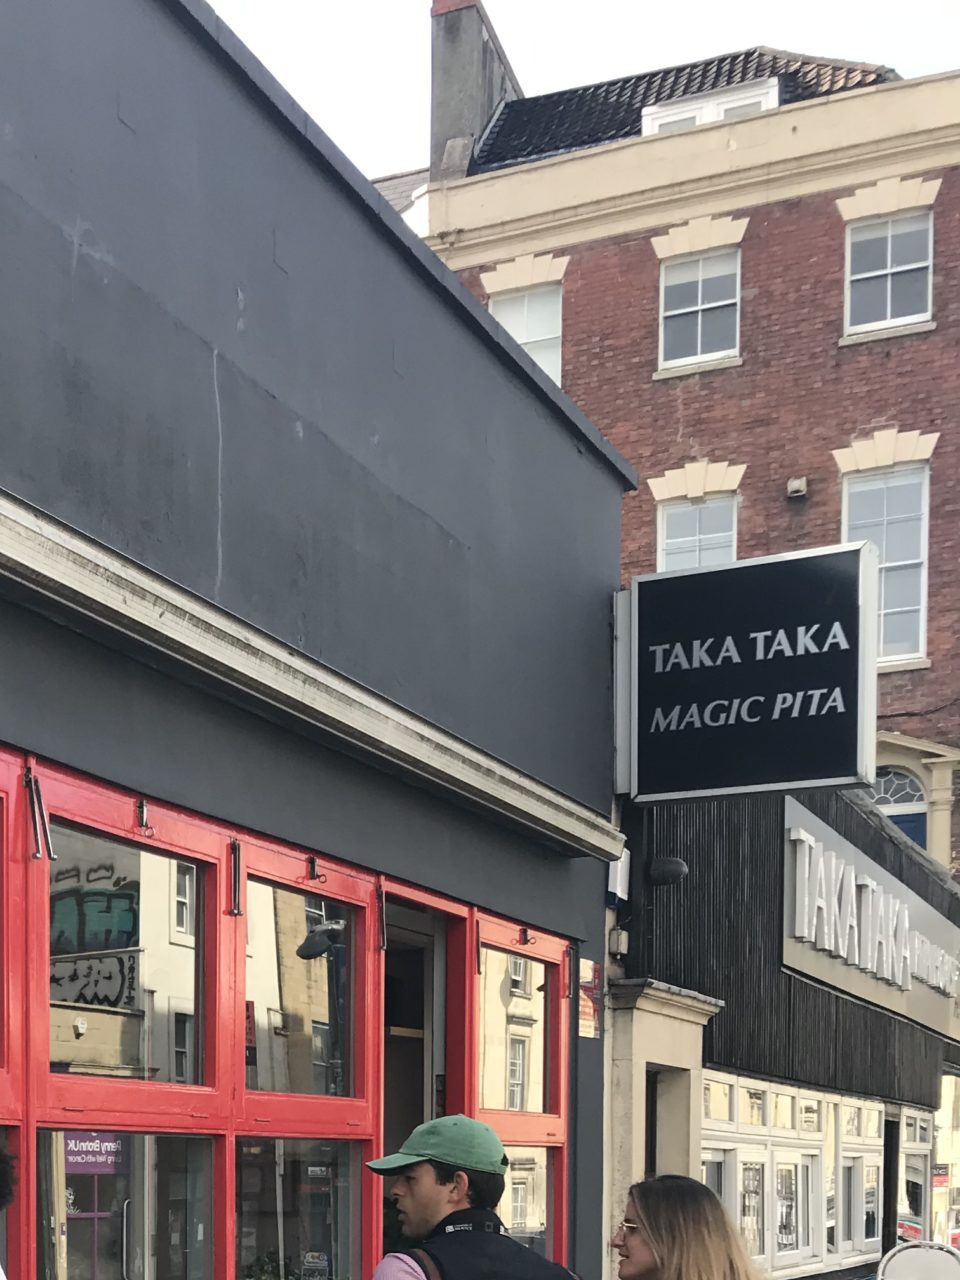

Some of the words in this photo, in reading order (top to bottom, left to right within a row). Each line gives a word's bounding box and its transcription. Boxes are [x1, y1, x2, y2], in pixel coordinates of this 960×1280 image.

[648, 635, 741, 673] TAKA
[749, 621, 850, 661] TAKA
[649, 695, 765, 733] MAGIC
[771, 686, 847, 722] PITA
[789, 827, 859, 966] TAKA
[856, 873, 912, 991] TAKA
